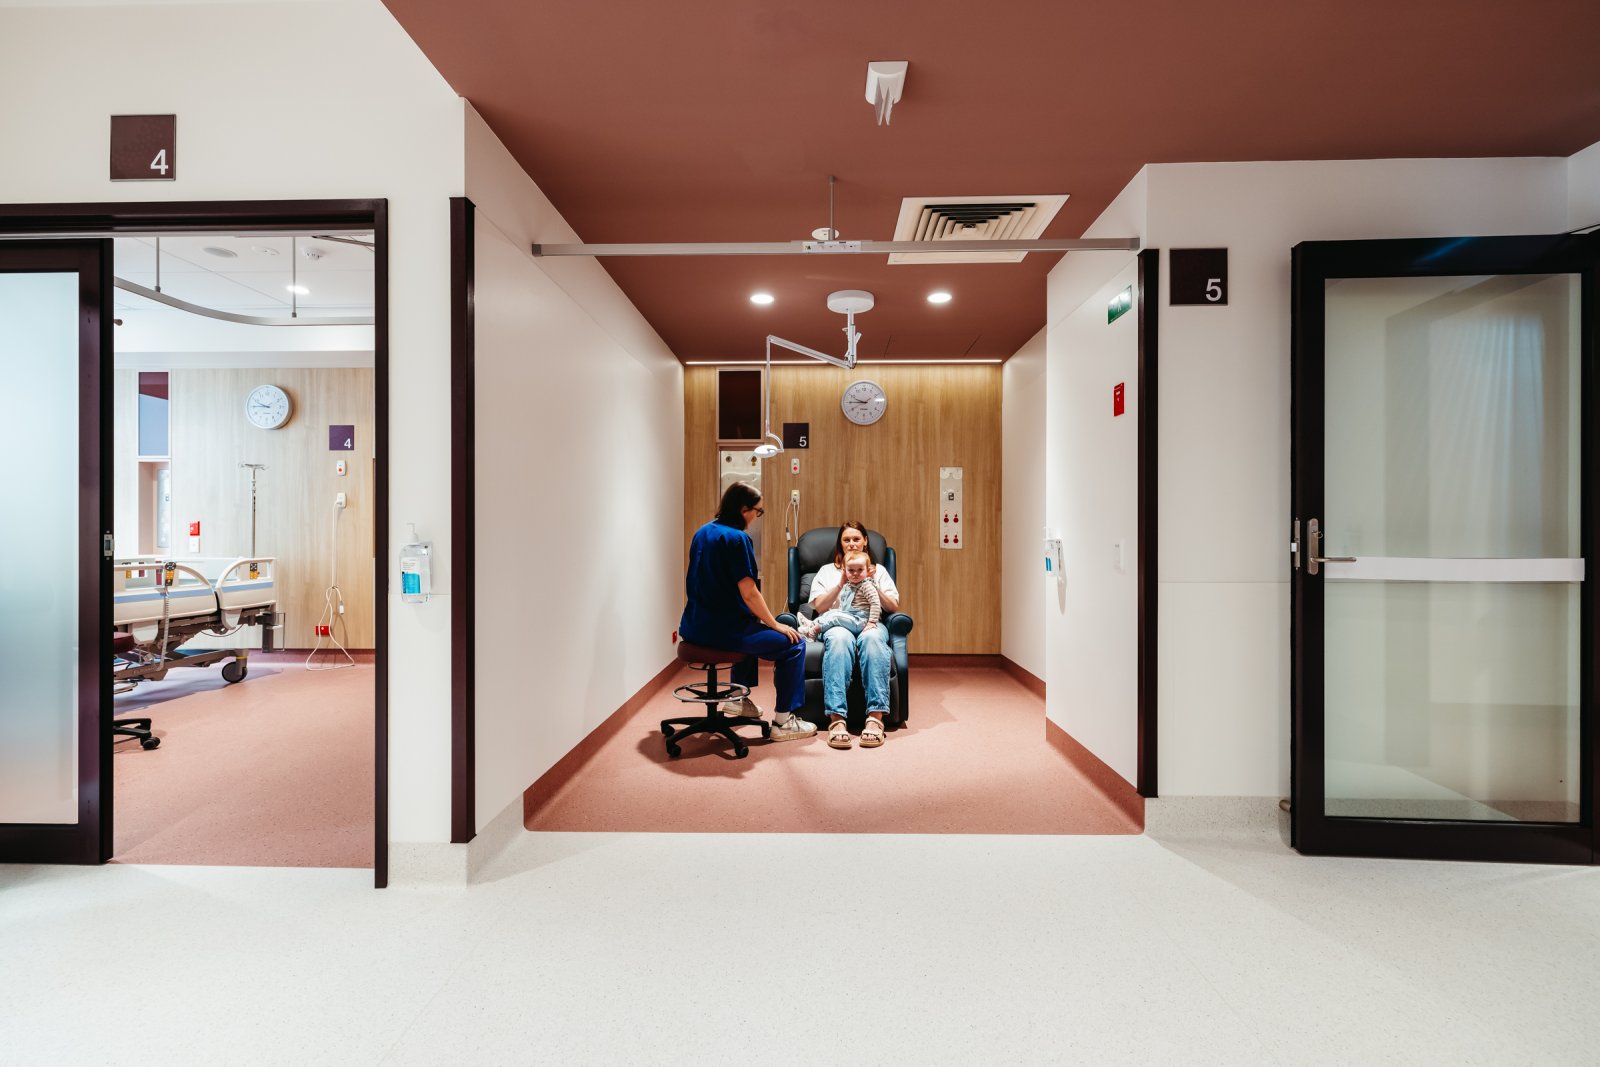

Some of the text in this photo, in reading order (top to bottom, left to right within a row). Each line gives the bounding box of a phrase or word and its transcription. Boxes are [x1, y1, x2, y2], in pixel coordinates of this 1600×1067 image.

[150, 149, 169, 175] 4
[1205, 278, 1222, 302] 5
[344, 438, 352, 449] 4
[799, 436, 807, 447] 5
